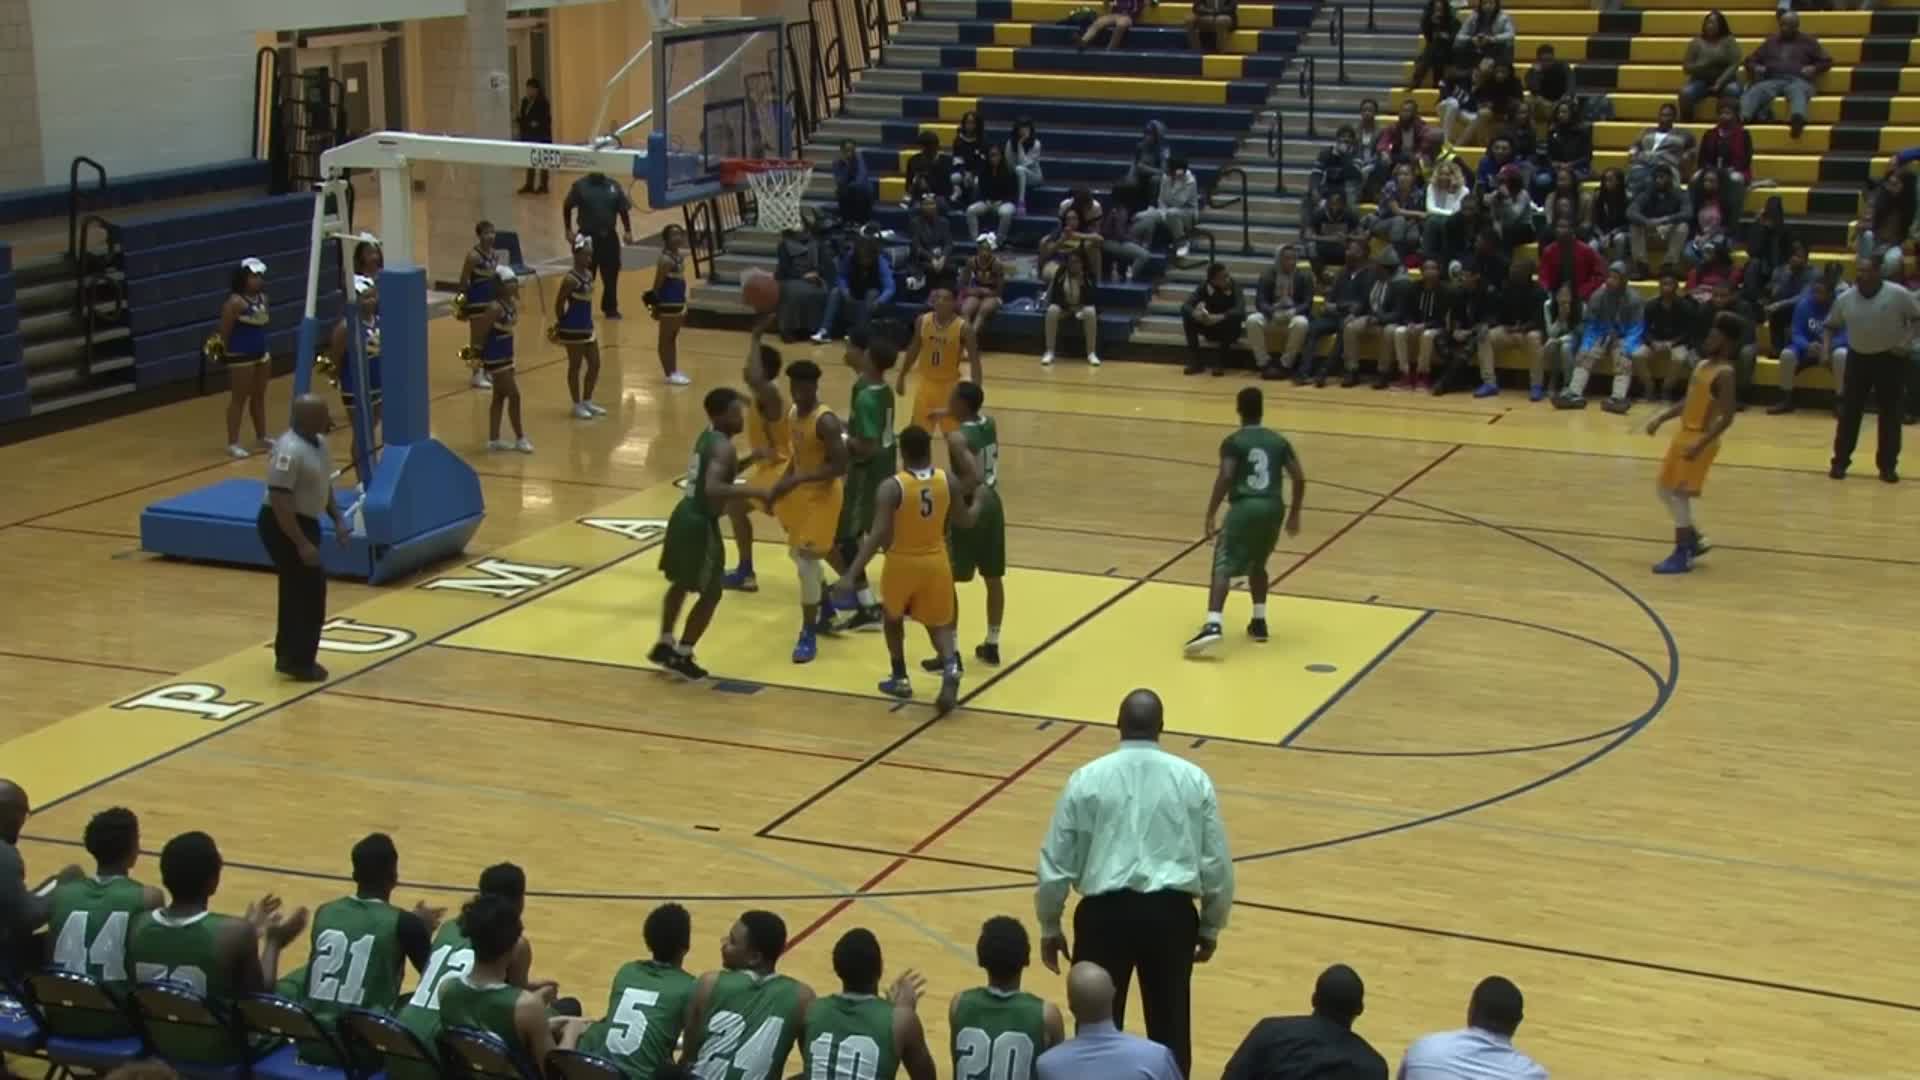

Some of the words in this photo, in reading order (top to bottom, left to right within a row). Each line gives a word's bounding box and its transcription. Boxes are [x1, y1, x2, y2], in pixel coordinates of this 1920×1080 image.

[1247, 447, 1270, 490] 3
[919, 488, 933, 518] 5
[53, 910, 129, 981] 44
[308, 929, 376, 1005] 21
[409, 944, 475, 1010] 12
[605, 987, 660, 1056] 5
[690, 1010, 785, 1080] 24
[956, 1027, 1034, 1080] 20
[810, 1032, 880, 1080] 10
